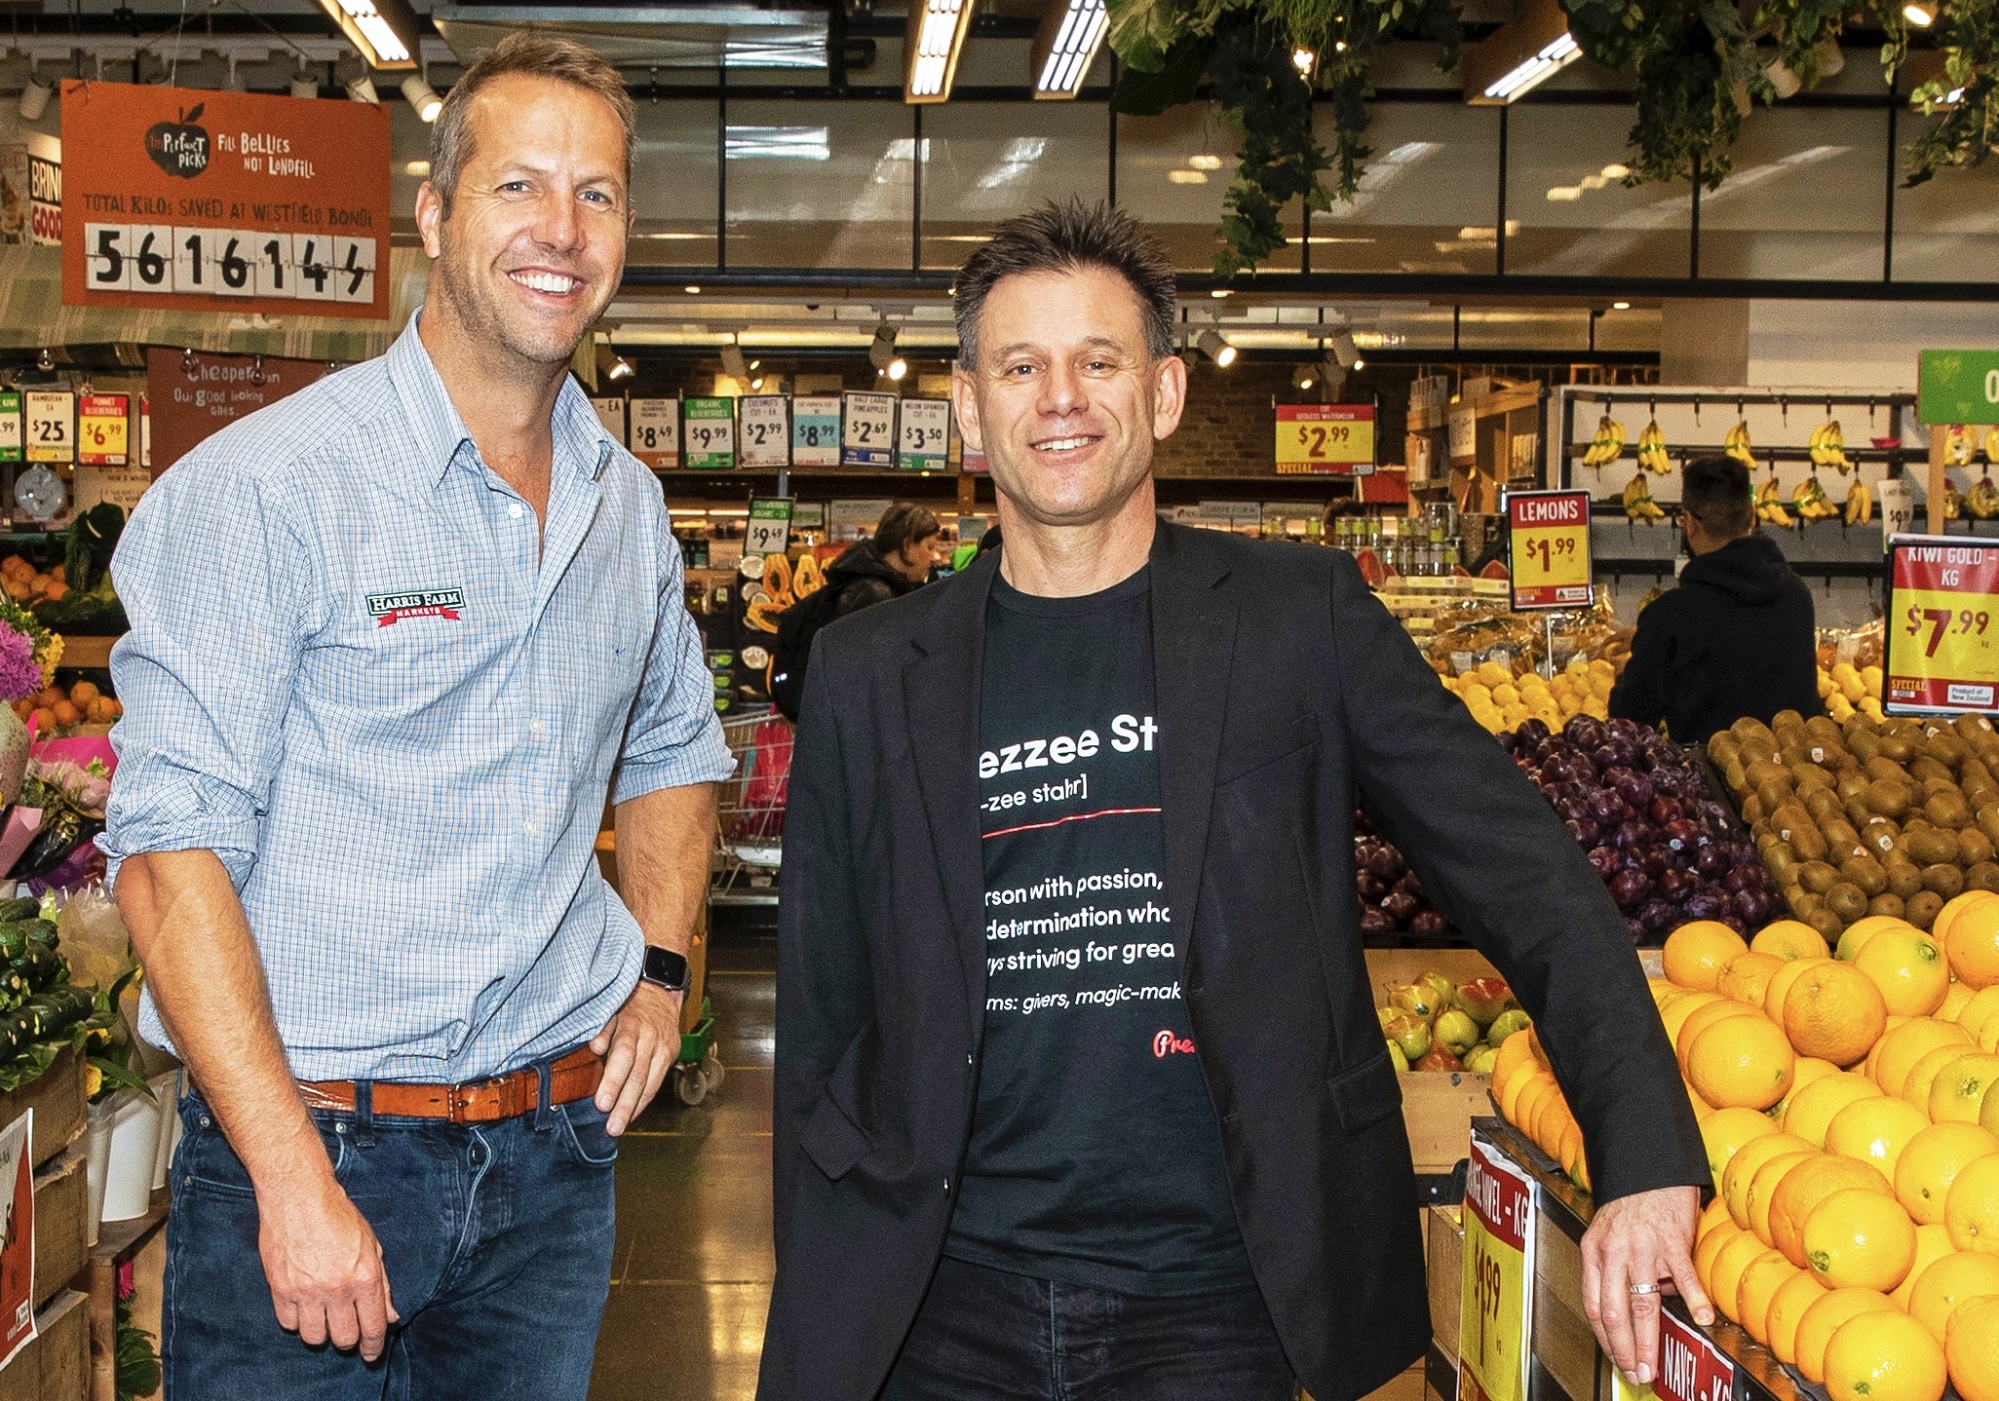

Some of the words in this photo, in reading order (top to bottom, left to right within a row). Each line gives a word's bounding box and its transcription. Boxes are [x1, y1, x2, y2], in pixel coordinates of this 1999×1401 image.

[244, 158, 262, 172] NOT
[83, 193, 126, 214] TOTAL
[179, 197, 223, 218] SAVED
[230, 203, 246, 220] AT
[608, 400, 620, 412] EA
[33, 419, 65, 441] $25
[86, 423, 122, 446] $6.99
[637, 426, 673, 448] $8.49
[692, 427, 727, 449] $9.99
[747, 423, 782, 445] $2.99
[800, 424, 835, 448] $8.99
[852, 420, 888, 443] $2.69
[906, 426, 943, 449] $3.50
[1298, 424, 1349, 458] $2.99
[1519, 500, 1579, 522] LEMONS
[753, 527, 783, 548] $9.49
[1526, 537, 1576, 573] $1.99
[1908, 546, 1942, 562] KIWI
[1947, 547, 1983, 565] GOLD
[1941, 569, 1959, 587] KG
[372, 595, 421, 611] HARRIS
[422, 592, 459, 606] FARM
[396, 606, 441, 617] MARKETS
[1906, 603, 1990, 658] $7.99
[1891, 679, 1927, 692] SPECIAL
[1032, 773, 1088, 802] stahr]
[1030, 875, 1073, 900] with
[1076, 868, 1164, 899] passion,
[986, 906, 1122, 940] determination
[1007, 948, 1081, 970] striving
[1086, 941, 1118, 962] for
[1022, 992, 1071, 1014] givers,
[1664, 1332, 1698, 1401] NAVEL
